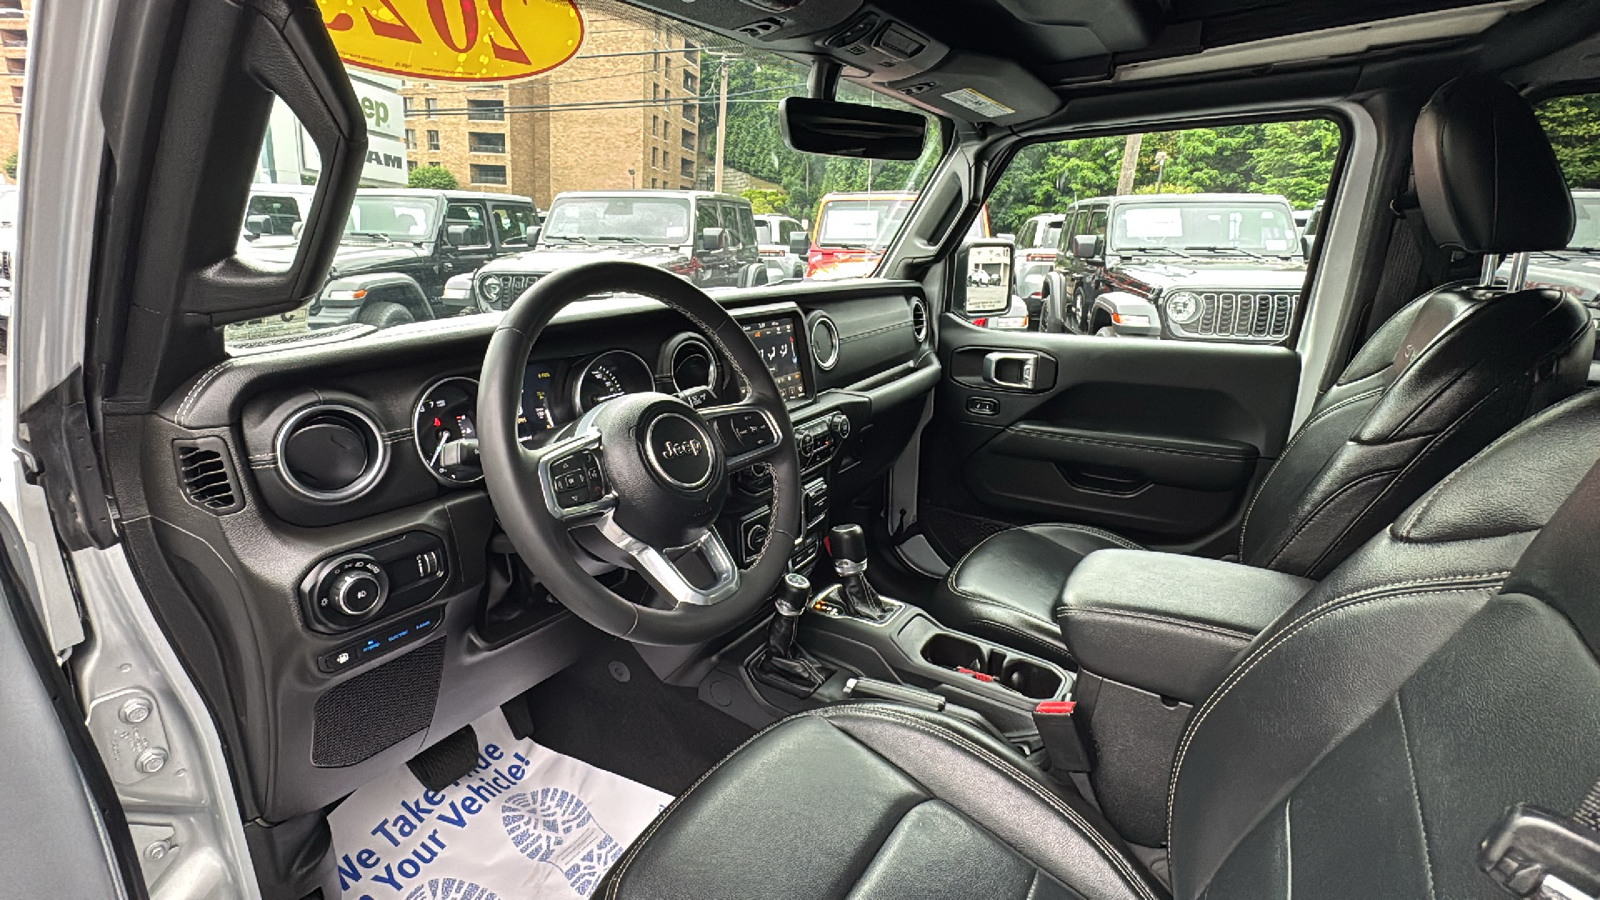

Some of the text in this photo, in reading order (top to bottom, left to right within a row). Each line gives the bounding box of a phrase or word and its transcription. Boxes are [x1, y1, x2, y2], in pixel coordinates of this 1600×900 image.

[361, 96, 389, 128] ep
[366, 150, 403, 170] AM
[662, 438, 702, 460] Jeep
[371, 788, 446, 847] Take
[371, 828, 447, 892] Your
[436, 751, 531, 829] Vehicle!
